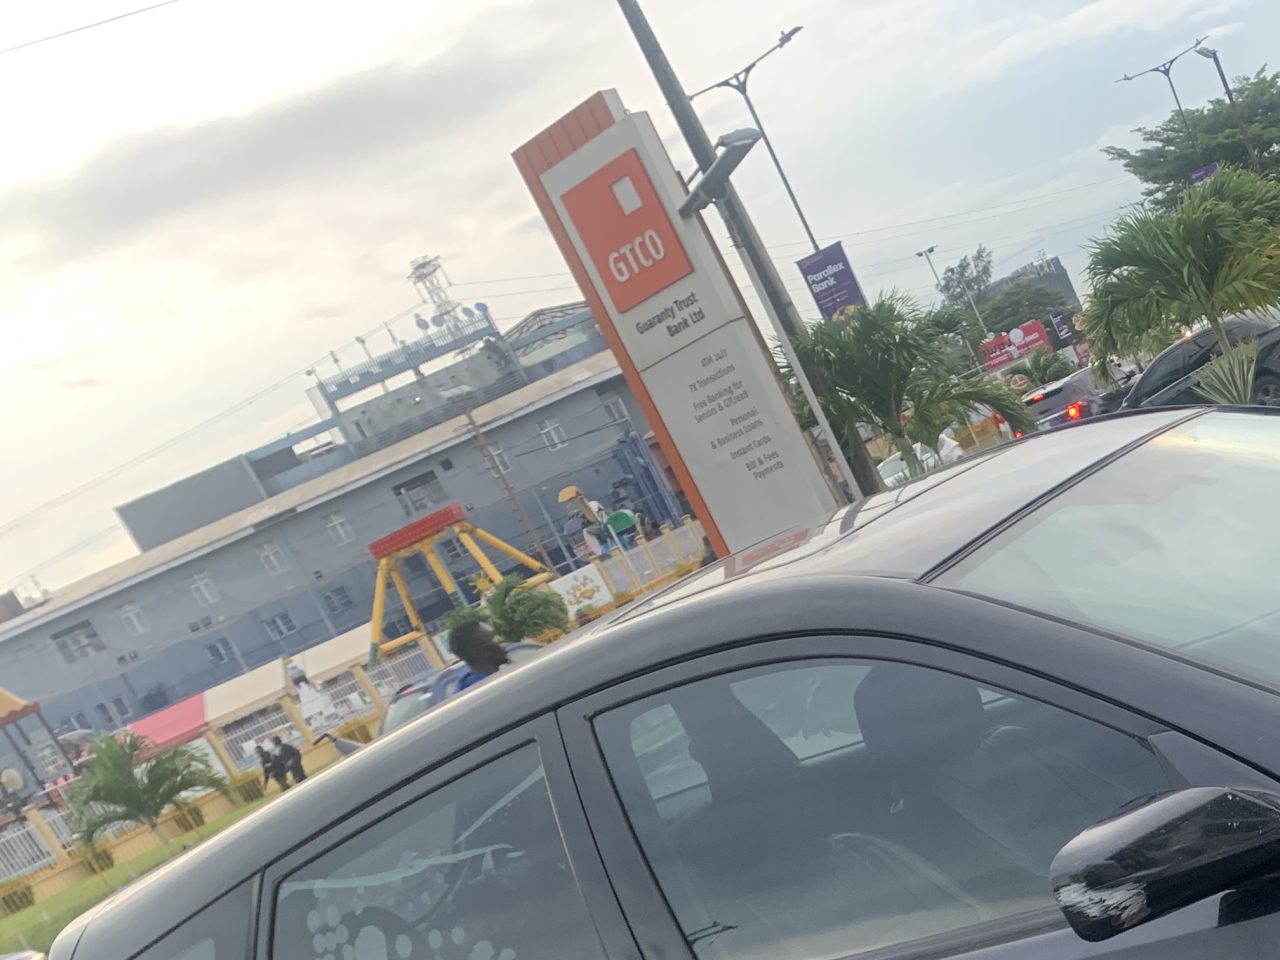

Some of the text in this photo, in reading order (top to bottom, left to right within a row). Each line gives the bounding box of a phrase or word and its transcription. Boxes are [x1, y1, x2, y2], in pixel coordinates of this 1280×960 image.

[608, 229, 665, 283] GTCO
[807, 262, 844, 284] Parallex
[812, 277, 837, 293] Bank
[636, 292, 698, 334] Guaranty Trust
[666, 307, 705, 337] Bank Ltd
[697, 364, 735, 388] Transactions
[693, 381, 743, 411] Free Banking for
[695, 407, 718, 423] Seniors
[729, 406, 759, 426] Personal
[717, 428, 744, 446] Business
[743, 419, 763, 433] Loans
[730, 435, 771, 460] Instant Cards
[763, 451, 779, 462] Fees
[753, 461, 784, 480] Payments
